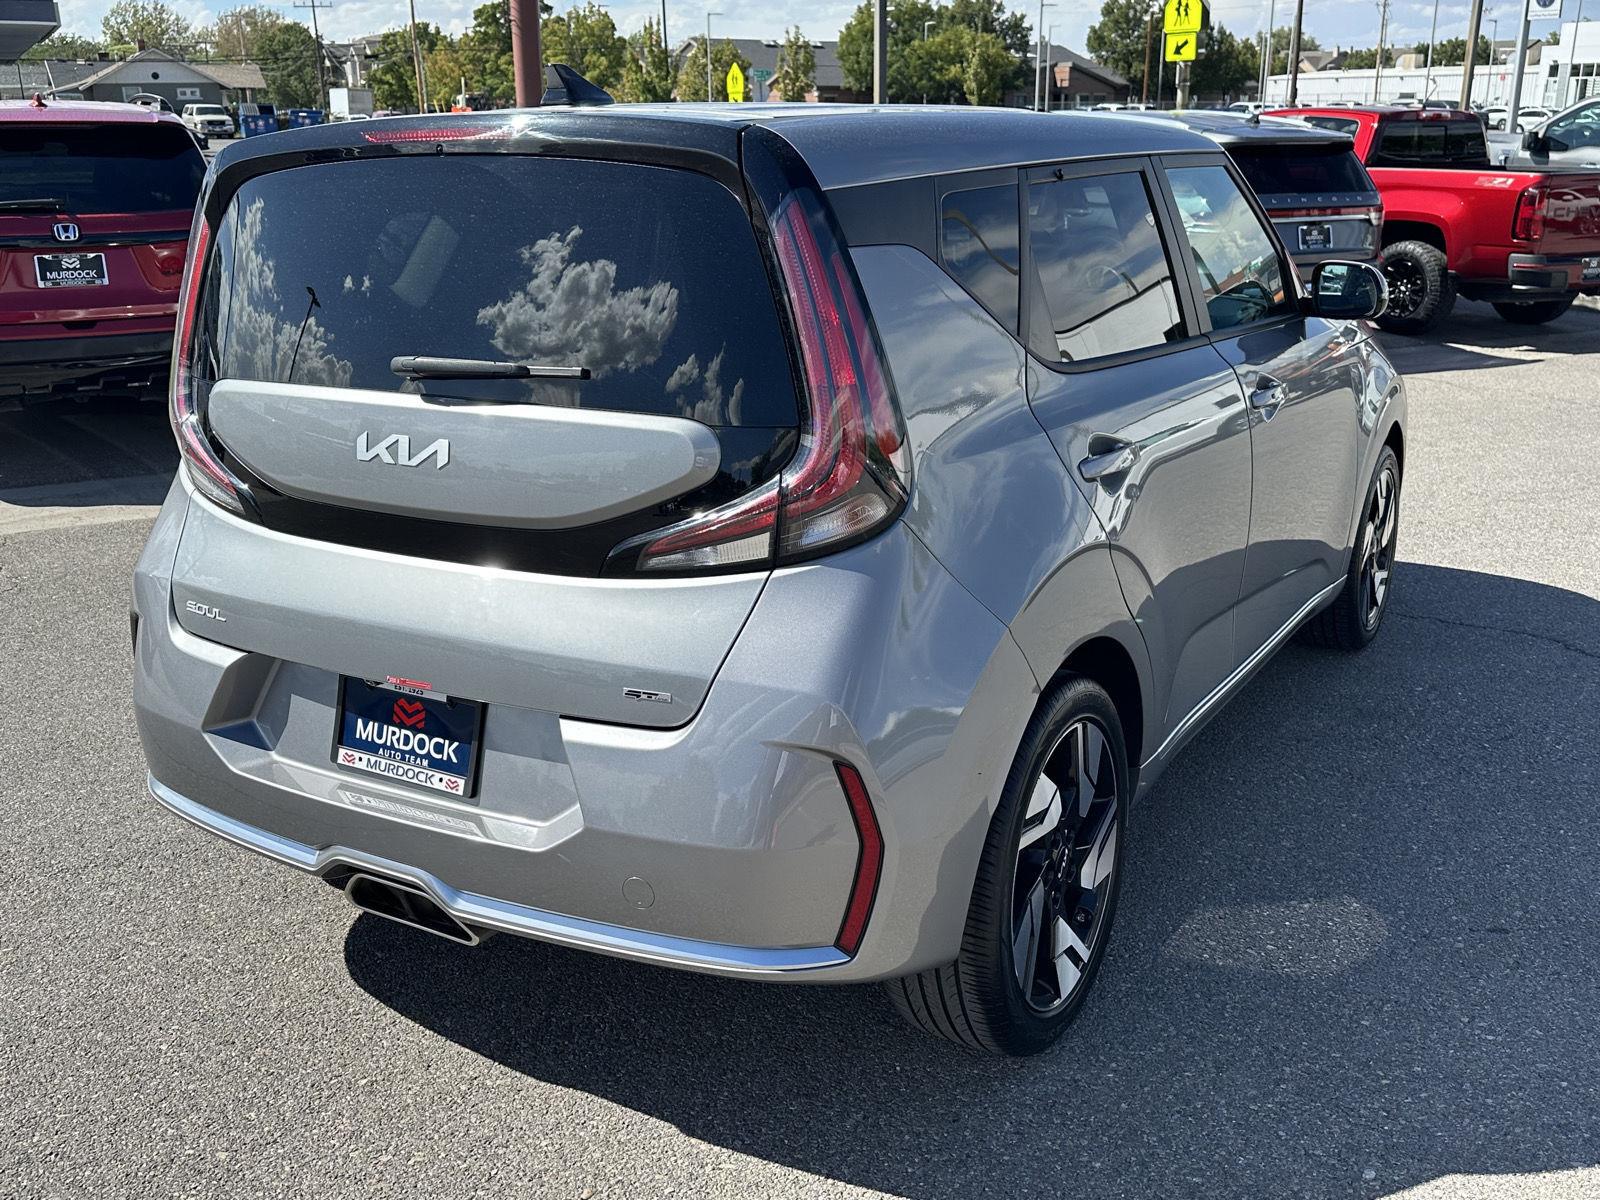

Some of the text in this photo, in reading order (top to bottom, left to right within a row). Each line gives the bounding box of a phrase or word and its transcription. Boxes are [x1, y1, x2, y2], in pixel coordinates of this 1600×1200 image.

[1271, 196, 1362, 204] LINCOLN
[46, 269, 98, 280] MURDOCK
[356, 430, 450, 471] KIA
[186, 600, 227, 622] SOUL
[355, 718, 459, 763] MURDOCK
[378, 747, 429, 768] AUTO TEAM
[366, 757, 436, 786] MURDOCK
